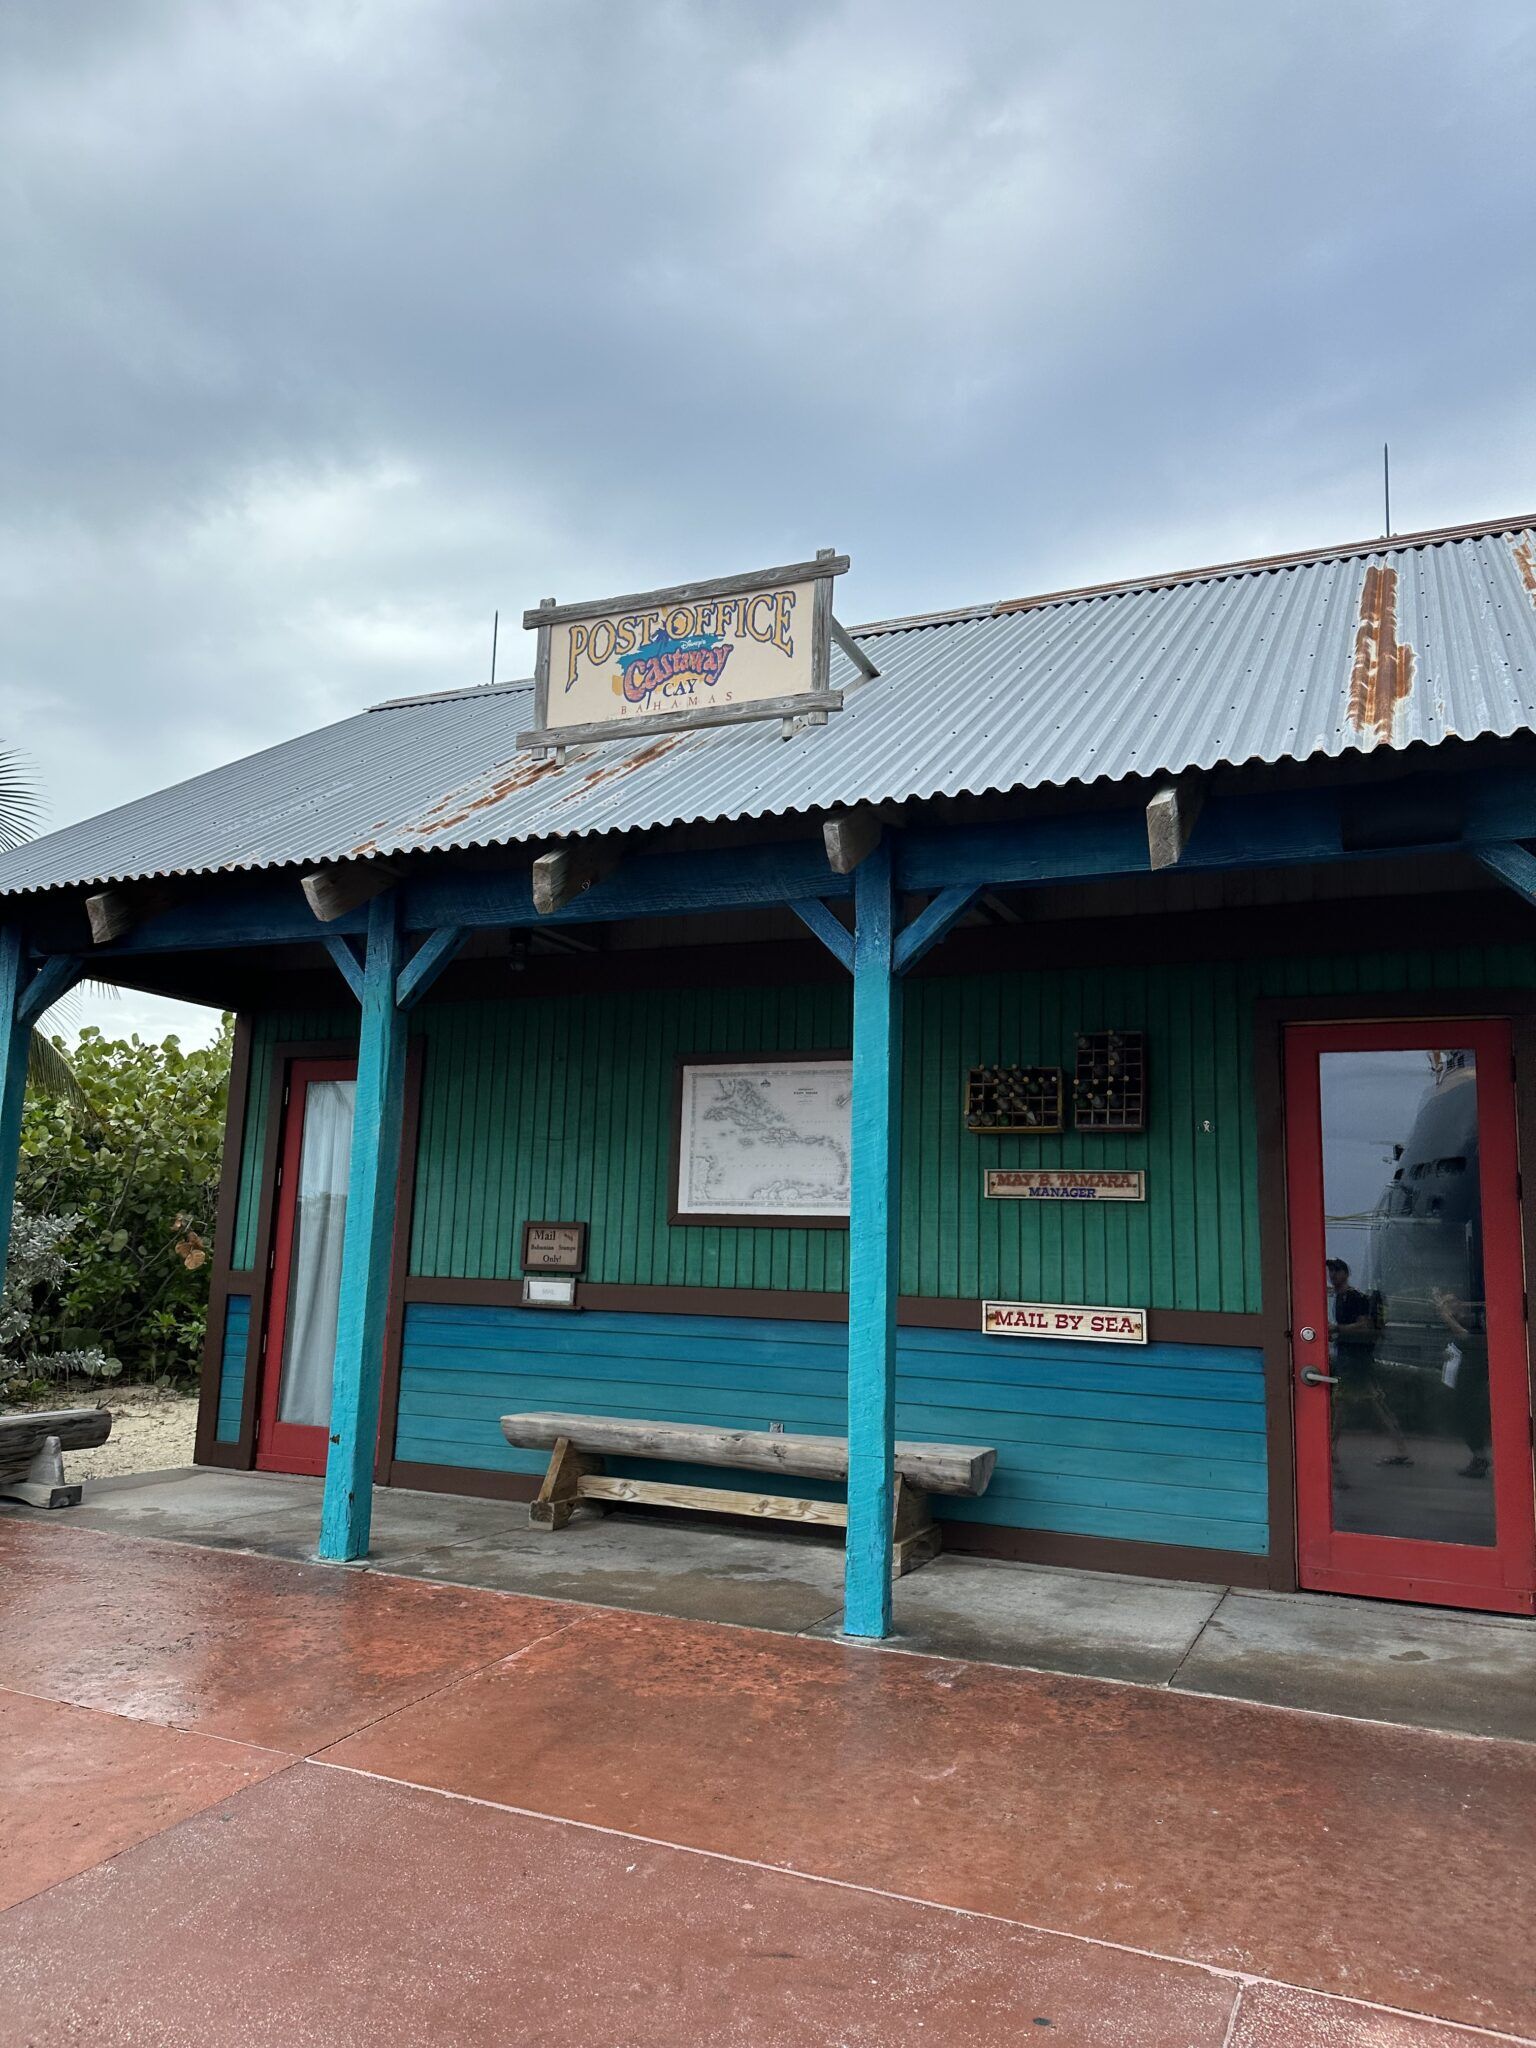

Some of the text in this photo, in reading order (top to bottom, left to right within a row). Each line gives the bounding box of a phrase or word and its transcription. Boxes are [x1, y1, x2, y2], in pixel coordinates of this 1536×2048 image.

[565, 590, 797, 693] POST OFFICE
[679, 638, 707, 650] Disney's
[622, 643, 734, 703] Castaway
[662, 678, 698, 698] CAY
[620, 691, 734, 715] BAHAMAS
[996, 1173, 1034, 1187] MAY
[1056, 1174, 1133, 1188] TAMARA
[1028, 1187, 1097, 1198] MANAGER
[534, 1230, 556, 1241] Mail
[543, 1255, 561, 1264] Only!
[994, 1310, 1135, 1333] MAIL BY SEA
